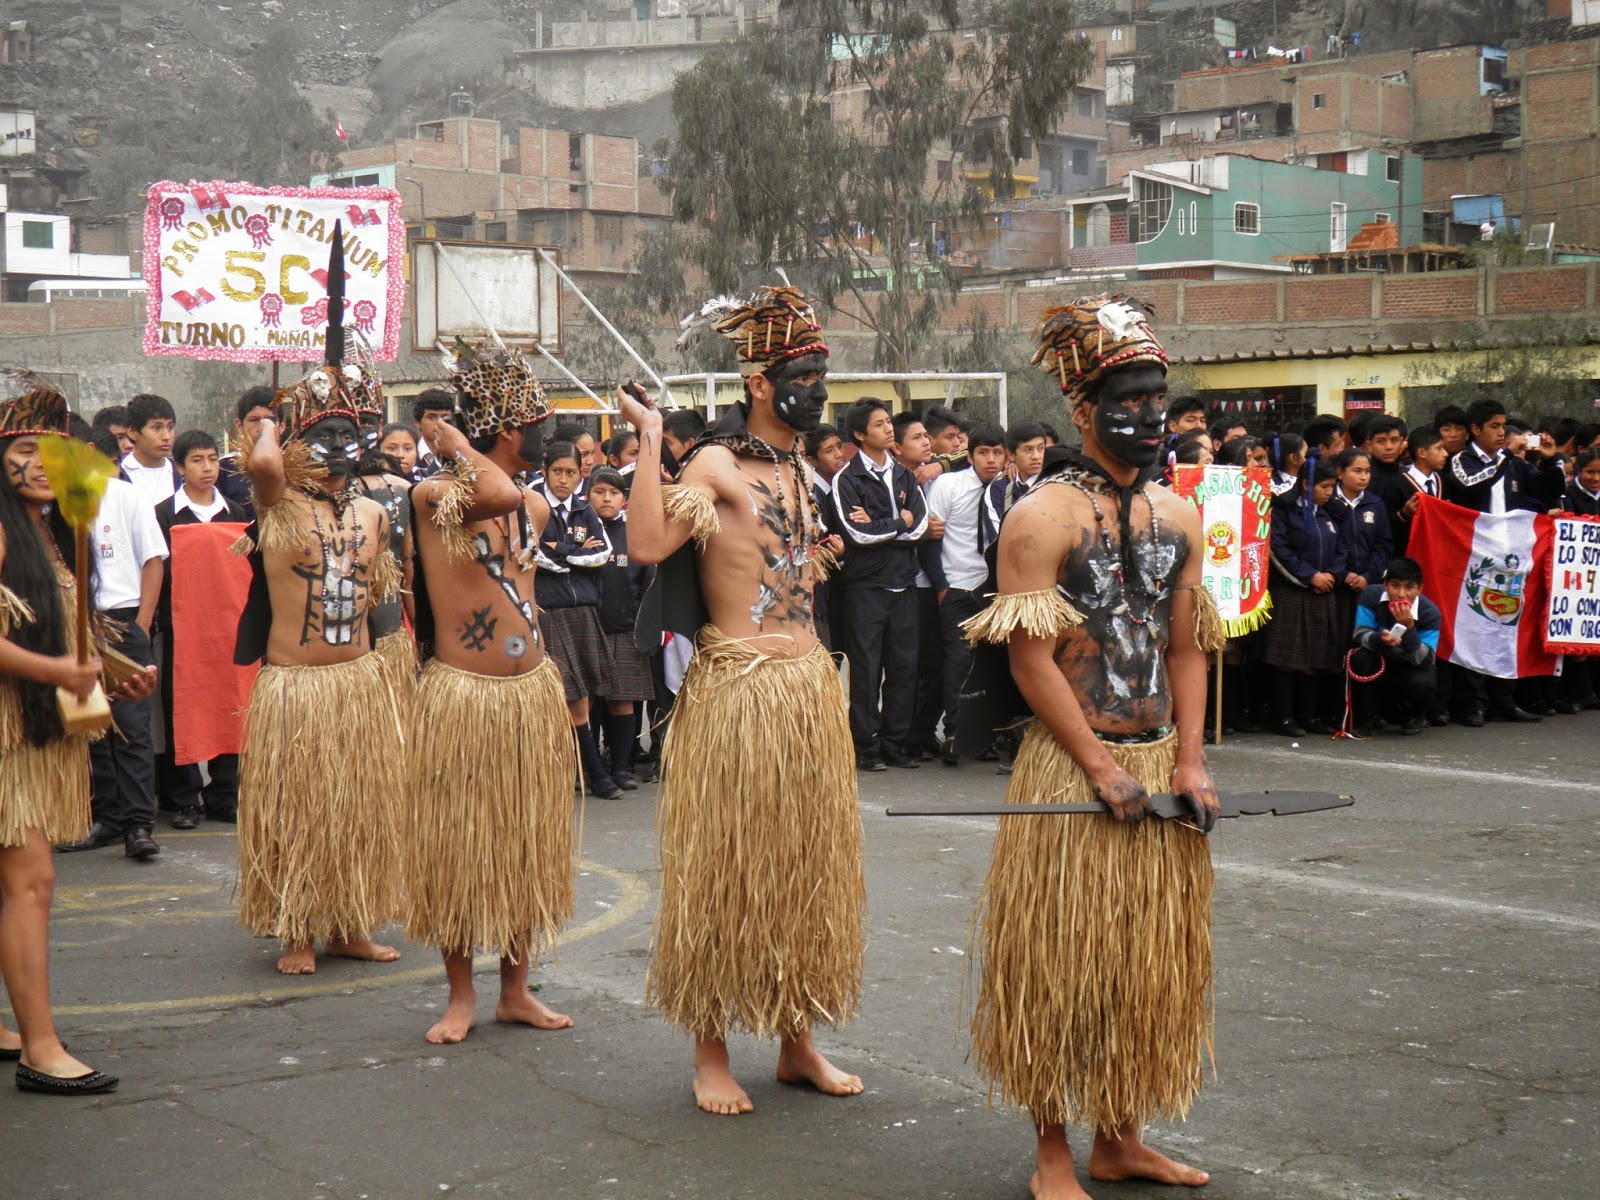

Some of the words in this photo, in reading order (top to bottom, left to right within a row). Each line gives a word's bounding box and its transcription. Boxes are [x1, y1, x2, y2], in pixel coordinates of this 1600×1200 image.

[162, 205, 248, 278] PROMO
[220, 251, 310, 305] 5C
[268, 330, 326, 347] MAÑAN
[1346, 378, 1356, 386] 2C
[1369, 376, 1380, 384] 2F
[1559, 523, 1577, 541] EL
[1558, 545, 1575, 564] LO
[1203, 572, 1251, 600] ERÚ
[1552, 596, 1569, 615] LO
[1577, 598, 1600, 616] COM
[1549, 618, 1573, 637] CON
